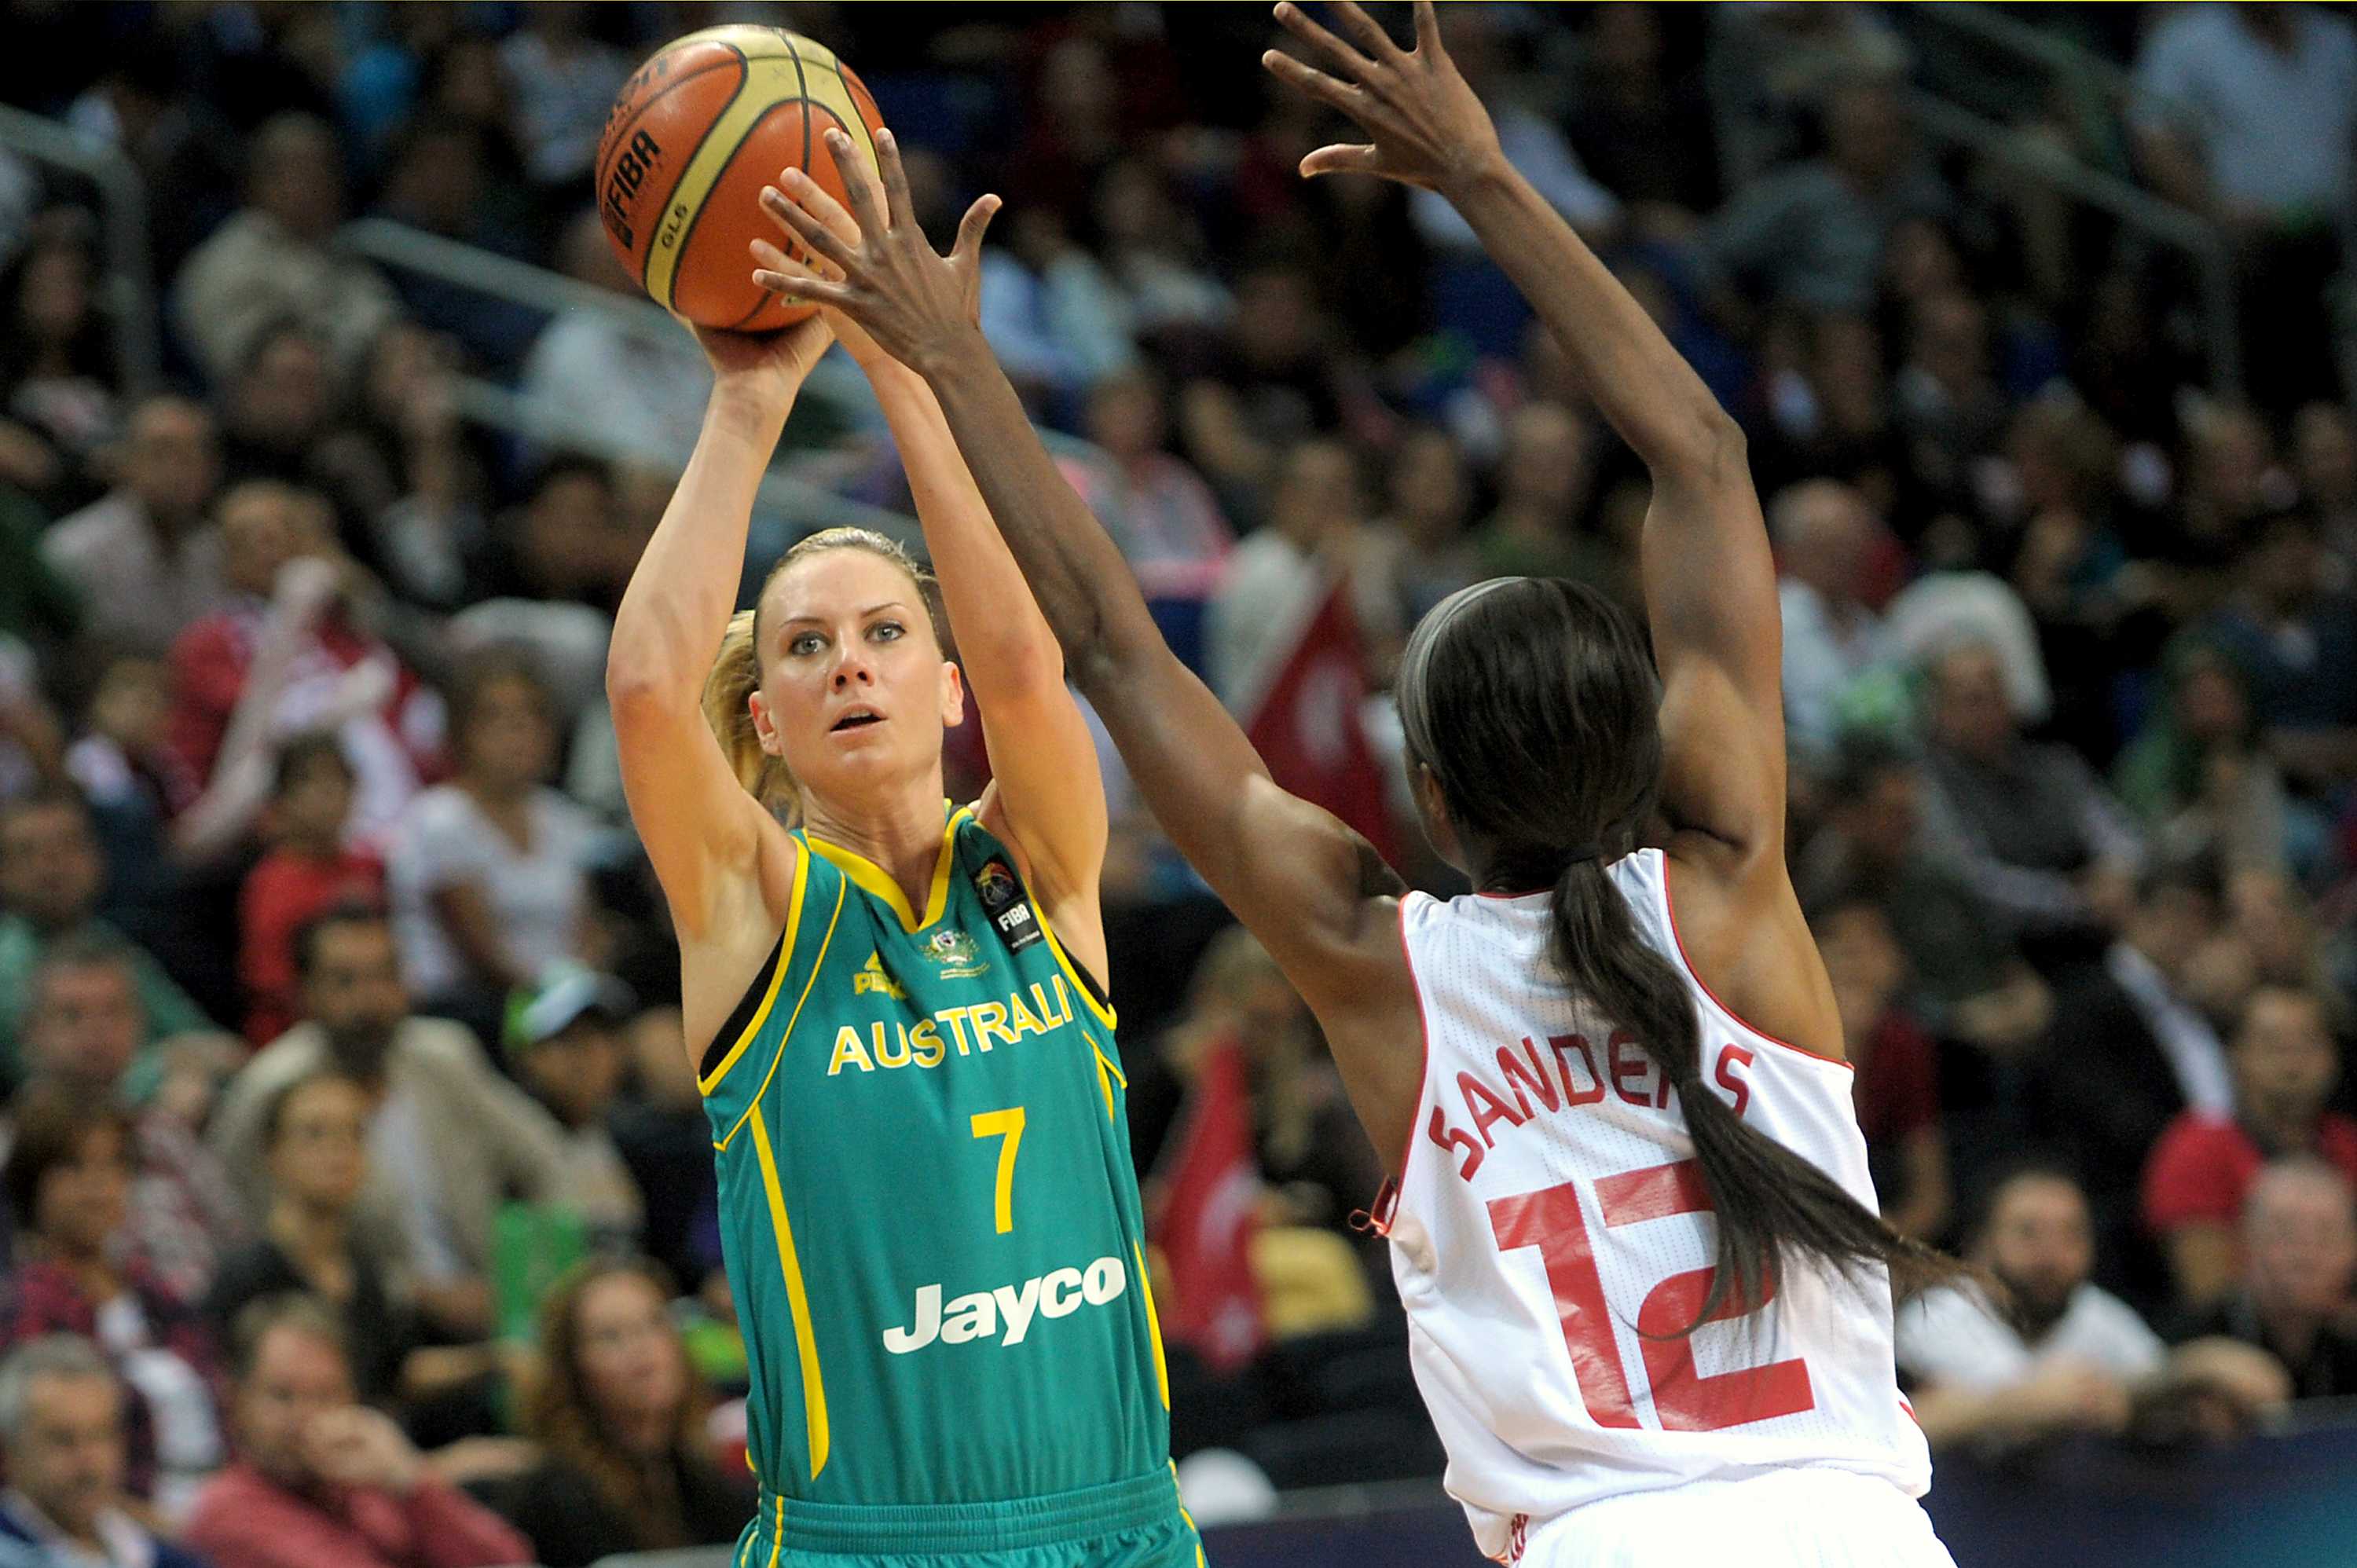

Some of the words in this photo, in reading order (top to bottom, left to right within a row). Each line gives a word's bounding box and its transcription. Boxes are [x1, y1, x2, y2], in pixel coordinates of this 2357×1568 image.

[607, 128, 661, 218] FIBA
[997, 903, 1031, 932] FIBA
[827, 974, 1073, 1076] AUSTRALI
[970, 1106, 1025, 1234] 7
[883, 1257, 1126, 1354] Jayco
[1486, 1158, 1815, 1431] 12
